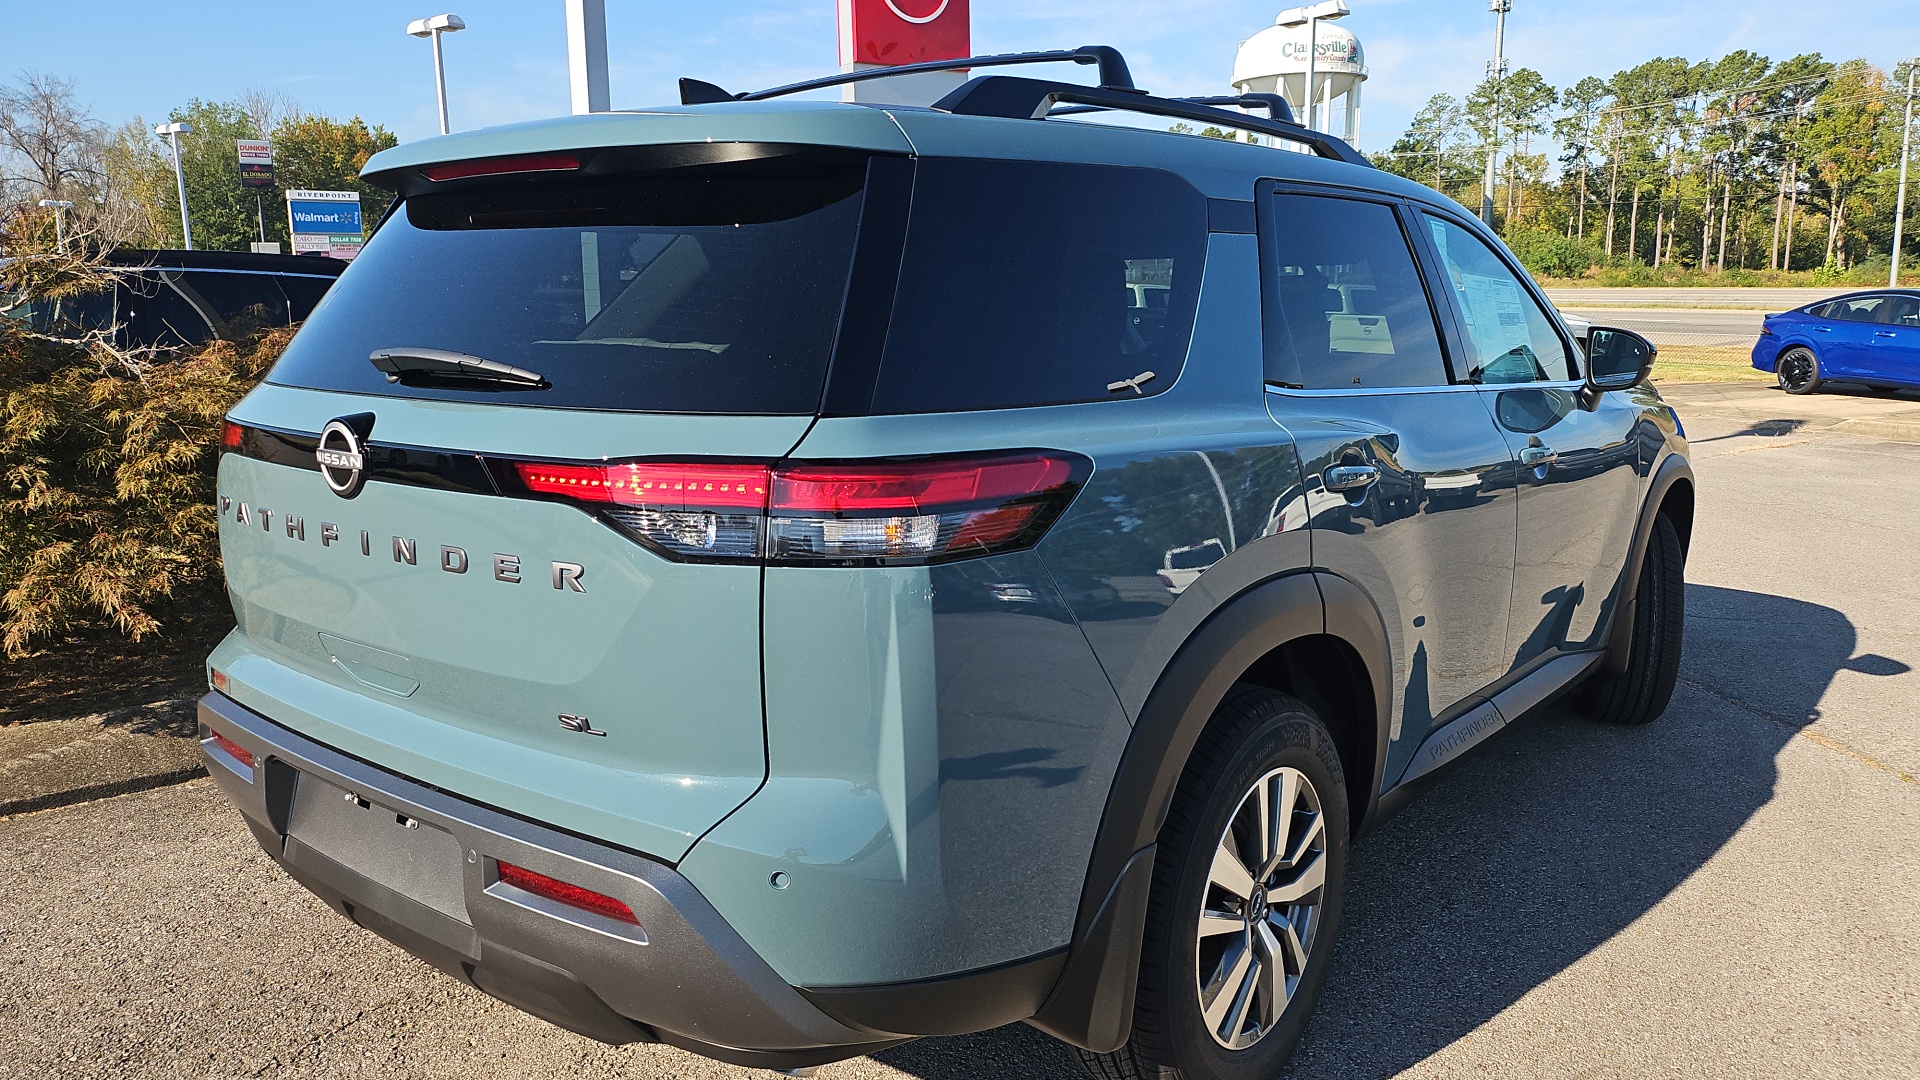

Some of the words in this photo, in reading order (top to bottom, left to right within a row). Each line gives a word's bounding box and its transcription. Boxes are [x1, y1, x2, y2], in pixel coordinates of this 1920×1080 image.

[1282, 41, 1347, 57] Claksville
[297, 191, 352, 199] RIVERPOINT
[293, 212, 339, 223] Walmart
[316, 450, 361, 468] NISSAN
[219, 493, 587, 593] PATHFINDER
[557, 712, 607, 737] SL
[1429, 710, 1500, 760] PATHFINDER
